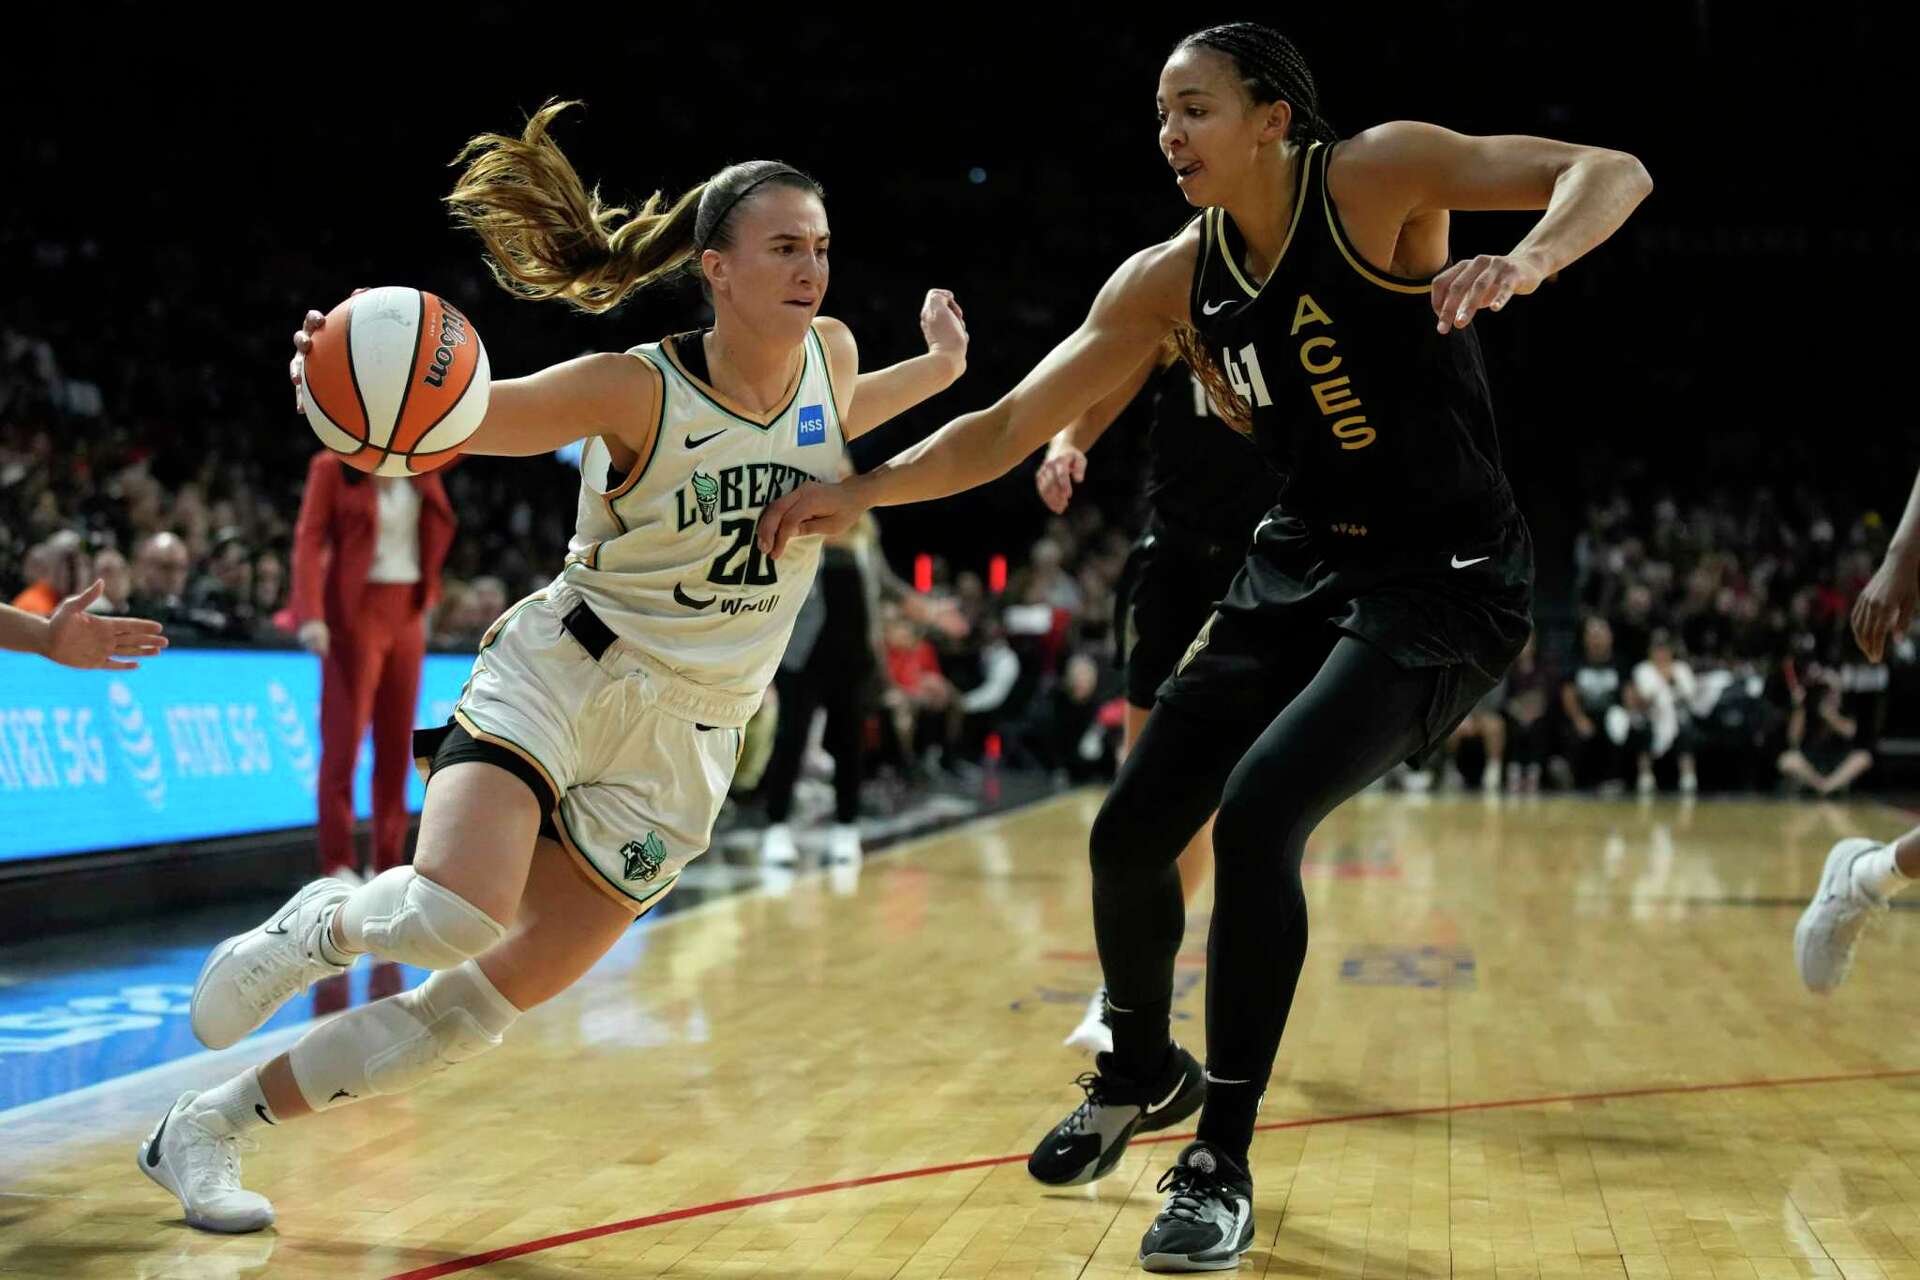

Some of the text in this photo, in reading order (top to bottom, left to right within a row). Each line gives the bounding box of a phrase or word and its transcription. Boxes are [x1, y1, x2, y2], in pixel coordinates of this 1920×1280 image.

[1223, 341, 1274, 408] 41
[1290, 294, 1377, 450] ACES
[800, 418, 824, 434] HSS
[675, 461, 822, 534] LIBERT
[706, 517, 778, 586] 20
